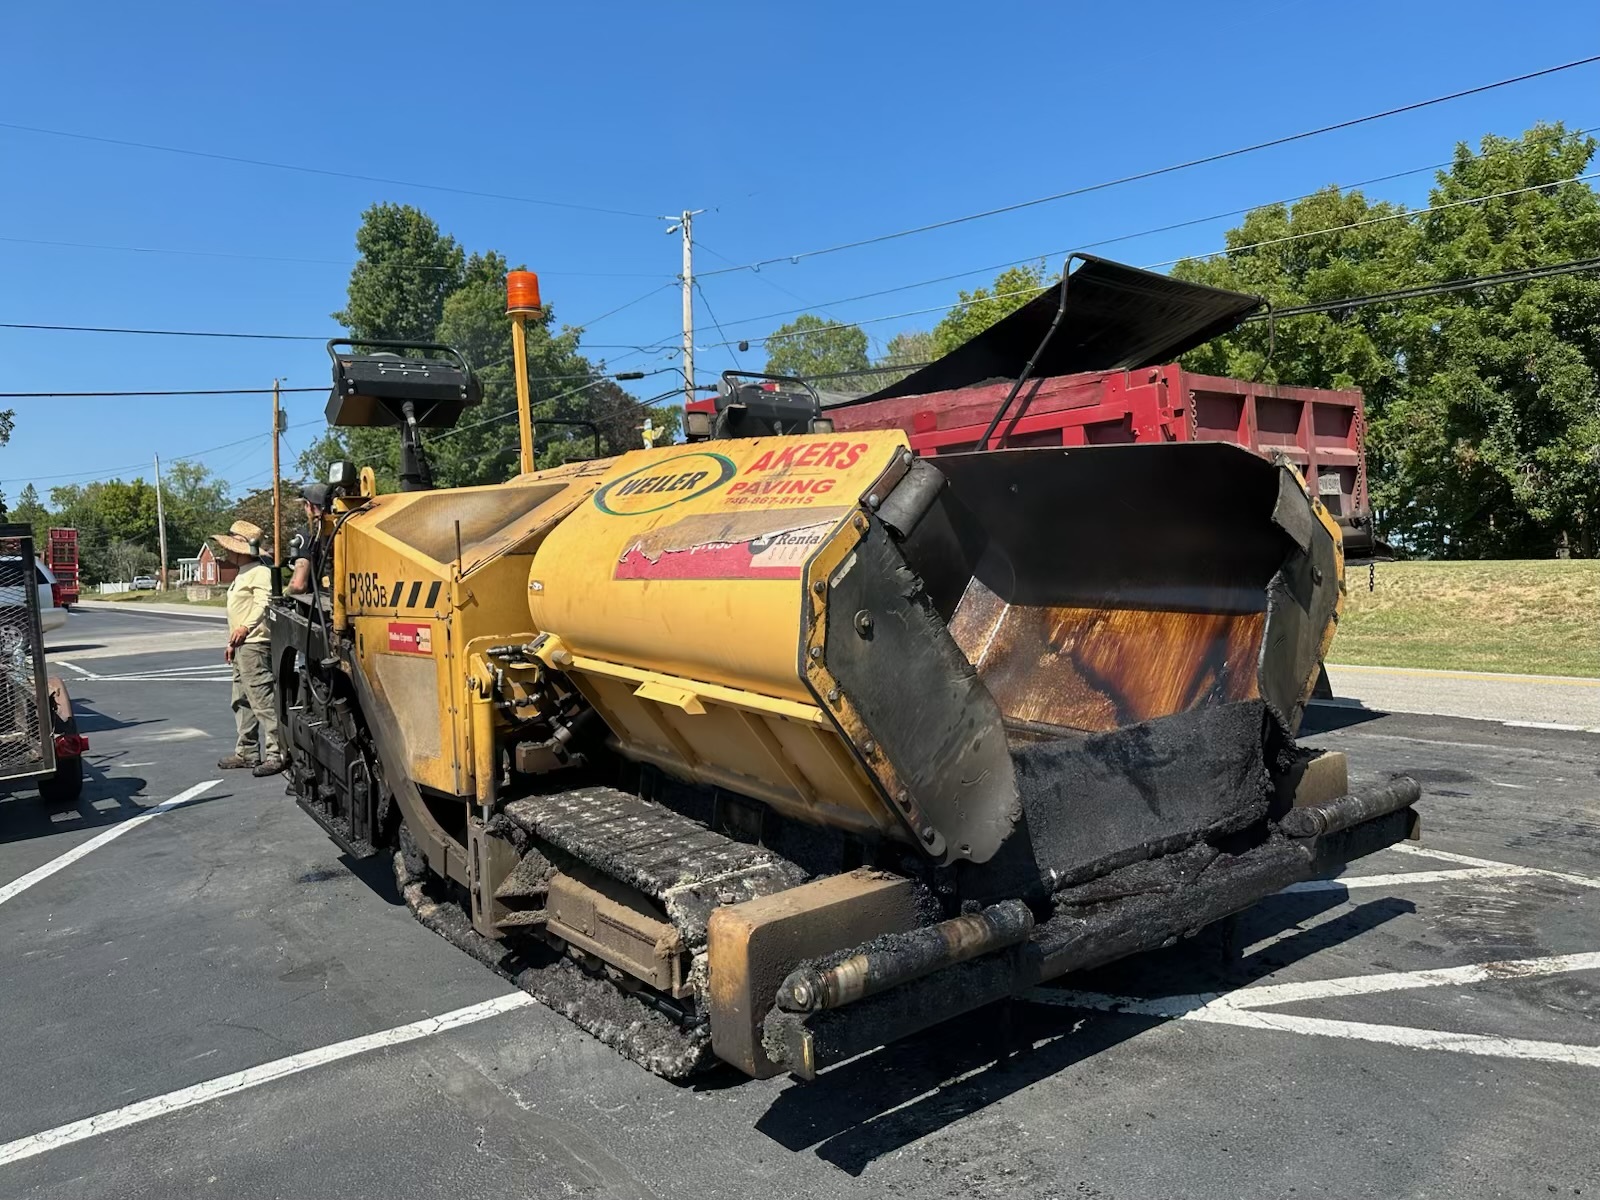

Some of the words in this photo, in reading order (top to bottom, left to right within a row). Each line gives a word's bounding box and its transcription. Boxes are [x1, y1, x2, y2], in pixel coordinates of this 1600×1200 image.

[743, 441, 868, 475] AKERS
[615, 471, 709, 497] WEILER
[726, 479, 836, 495] PAVING
